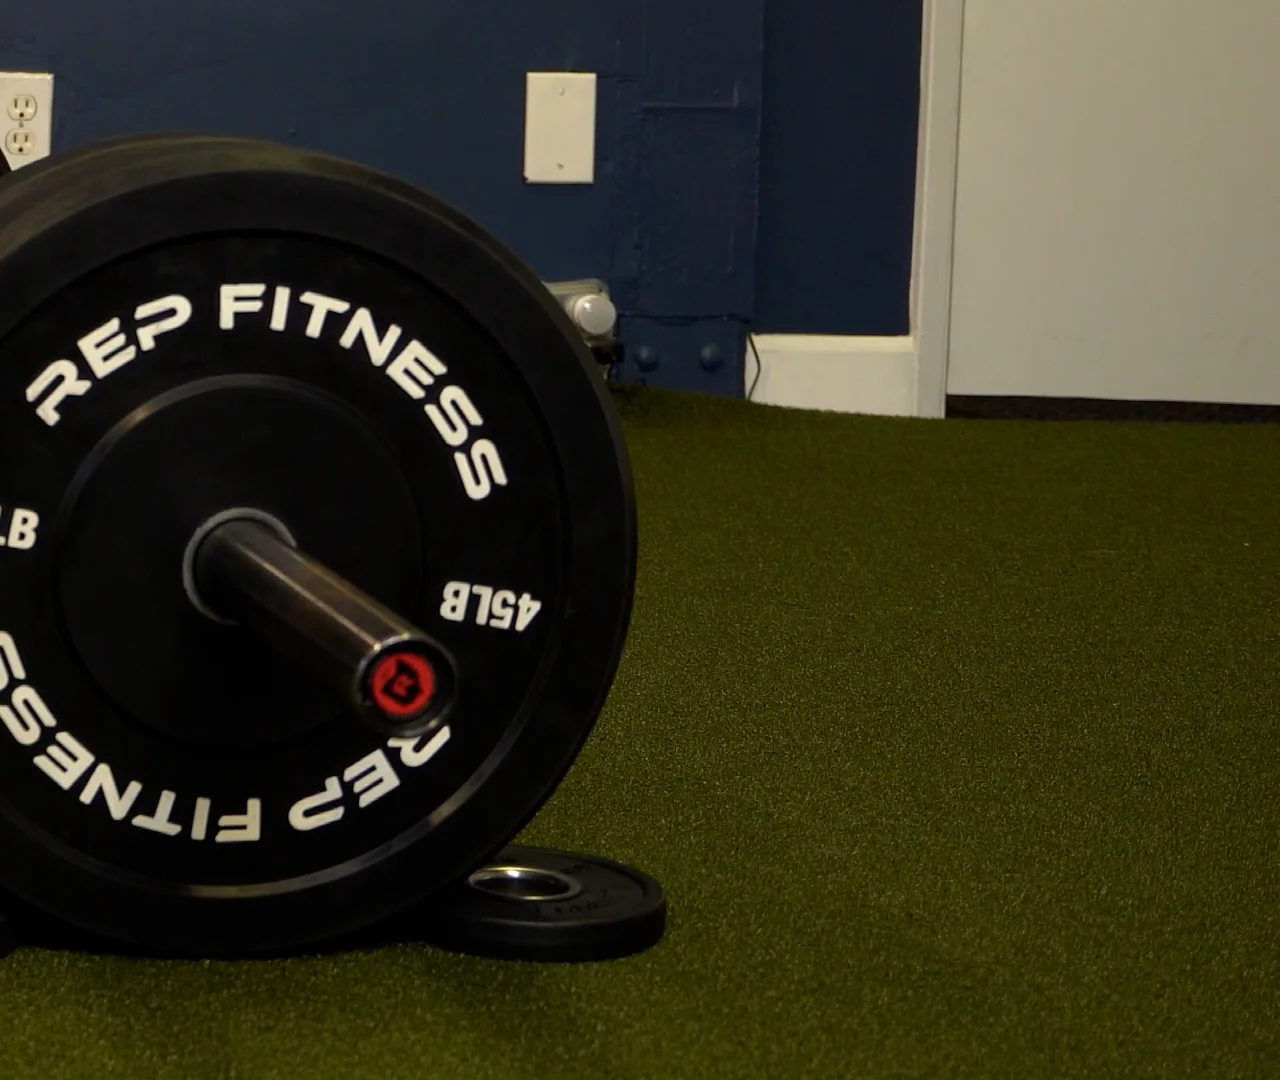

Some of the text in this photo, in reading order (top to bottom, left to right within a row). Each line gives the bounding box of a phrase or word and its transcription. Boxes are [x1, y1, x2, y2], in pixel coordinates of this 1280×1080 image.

[25, 282, 508, 500] REP FITNESS
[438, 580, 543, 632] 45LB
[288, 724, 452, 832] REP
